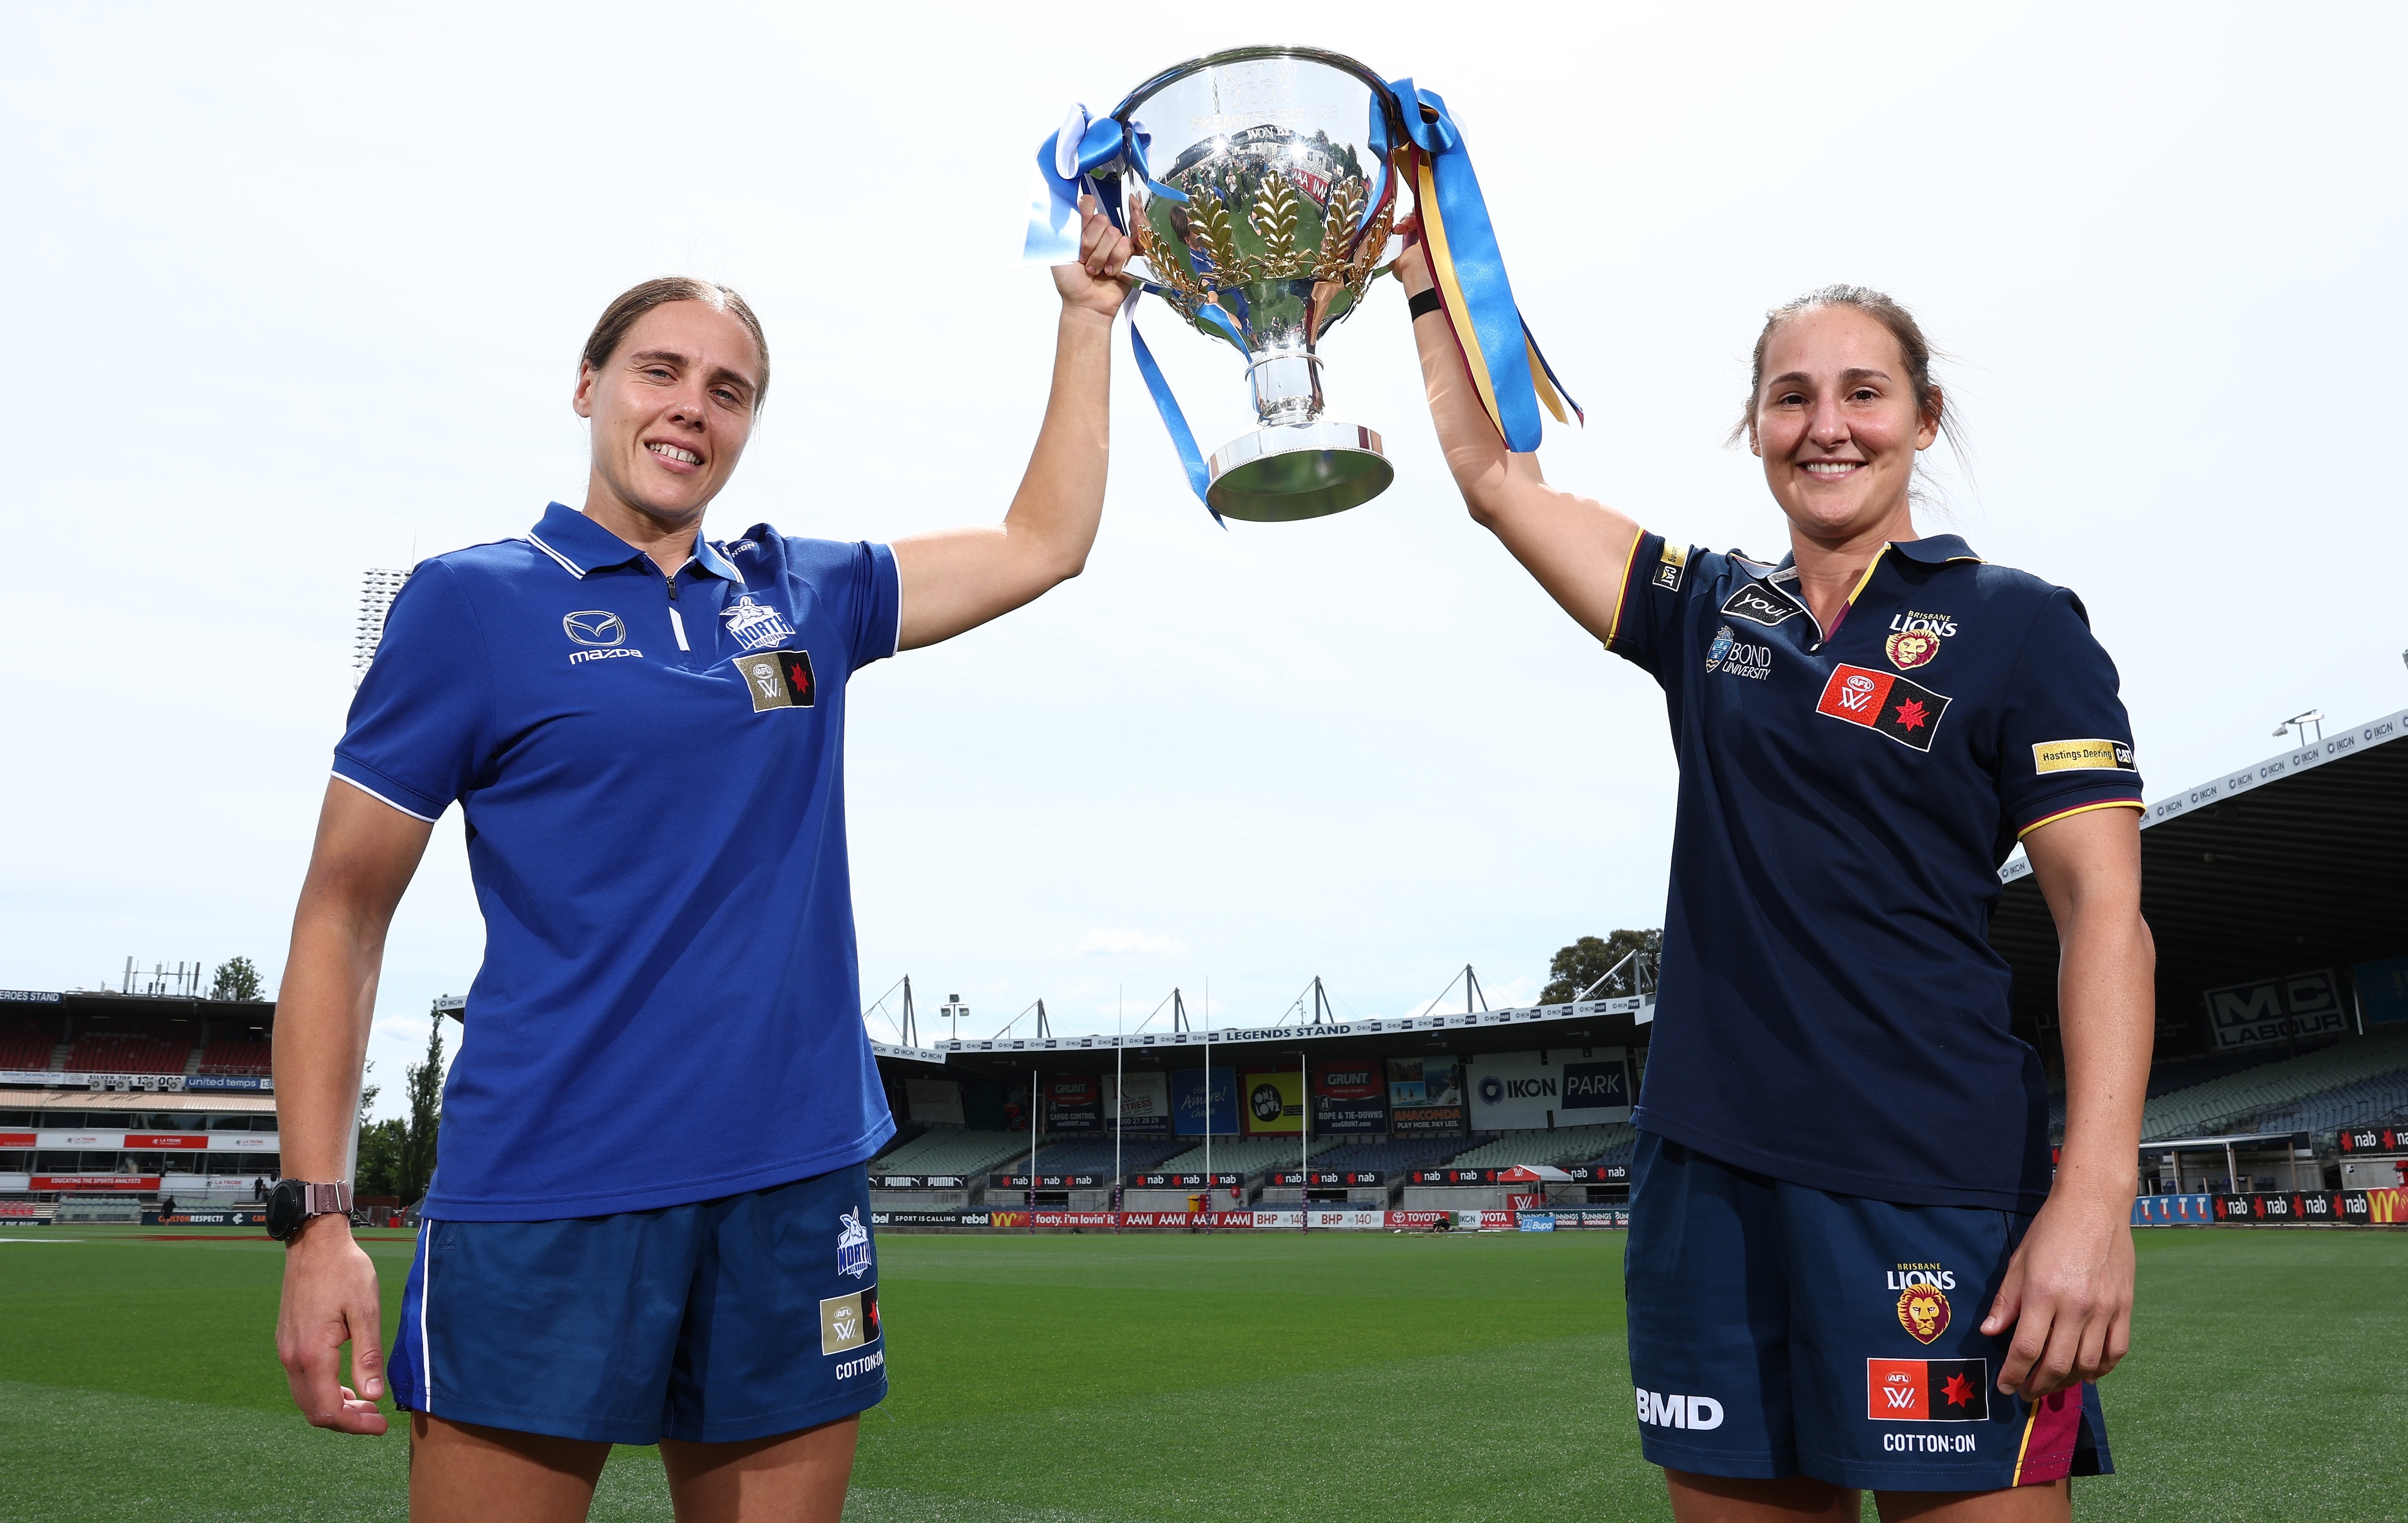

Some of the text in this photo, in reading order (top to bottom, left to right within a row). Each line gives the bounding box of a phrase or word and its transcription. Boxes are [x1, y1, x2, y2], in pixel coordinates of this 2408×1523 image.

[1221, 62, 1299, 91] AFLW
[1228, 84, 1295, 110] 2025
[1189, 107, 1306, 130] PREMIERSHIP
[1246, 127, 1274, 140] WON
[1662, 566, 1676, 586] CAT
[1735, 594, 1793, 617] youi
[1908, 611, 1950, 622] BRISBANE
[733, 613, 793, 647] NORTH
[1889, 614, 1958, 637] LIONS
[755, 633, 786, 646] MELBOURNE
[1728, 642, 1771, 667] BOND
[1722, 661, 1771, 680] UNIVERSITY
[1851, 677, 1870, 689] AFL
[2374, 722, 2393, 737] IKON
[2337, 736, 2355, 750] IKON
[2043, 748, 2131, 763] Hastings Deering CAT
[2302, 749, 2318, 763] IKON
[2268, 761, 2284, 774] IKON
[2238, 773, 2252, 786] IKON
[2200, 786, 2217, 799] IKON
[2166, 800, 2182, 813] IKON
[2010, 862, 2025, 874] IKON
[30, 992, 59, 1002] STAND
[2214, 977, 2330, 1024] MC
[1227, 1025, 1351, 1041] LEGENDS STAND
[2219, 1014, 2343, 1046] LABOUR
[1327, 1073, 1368, 1085] GRUNT
[1055, 1084, 1086, 1093] GRUNT
[1507, 1074, 1619, 1098] IKON PARK
[1121, 1099, 1152, 1112] STRESS
[1395, 1109, 1461, 1120] ANACONDA
[2355, 1131, 2376, 1146] nab
[1286, 1173, 1301, 1183] nab
[1322, 1173, 1337, 1183] nab
[1358, 1172, 1374, 1182] nab
[1424, 1171, 1440, 1181] nab
[1461, 1171, 1477, 1180] nab
[1571, 1168, 1587, 1178] nab
[1608, 1167, 1625, 1177] nab
[885, 1177, 911, 1186] PUMA
[928, 1177, 954, 1186] PUMA
[1013, 1177, 1028, 1185] nab
[1076, 1176, 1092, 1185] nab
[1148, 1175, 1164, 1184] nab
[1183, 1175, 1200, 1184] nab
[1219, 1175, 1236, 1184] nab
[2228, 1198, 2247, 1214] nab
[2267, 1197, 2287, 1214] nab
[2305, 1195, 2327, 1213] nab
[2345, 1194, 2367, 1213] nab
[962, 1214, 988, 1224] rebel
[1036, 1214, 1115, 1226] footy. i'm lovin' it
[1126, 1214, 1152, 1225] AAMI
[1159, 1214, 1185, 1225] AAMI
[1224, 1214, 1250, 1225] AAMI
[1257, 1214, 1278, 1224] BHP
[1322, 1214, 1371, 1224] BHP 140
[1408, 1213, 1440, 1222] TOYOTA
[1533, 1222, 1551, 1230] Bupa
[838, 1240, 871, 1274] NORTH
[1887, 1271, 1955, 1290] LIONS
[836, 1308, 851, 1317] AFL
[836, 1350, 884, 1380] COTTON:ON
[1636, 1387, 1724, 1430] BMD
[1884, 1433, 1976, 1452] COTTON:ON
